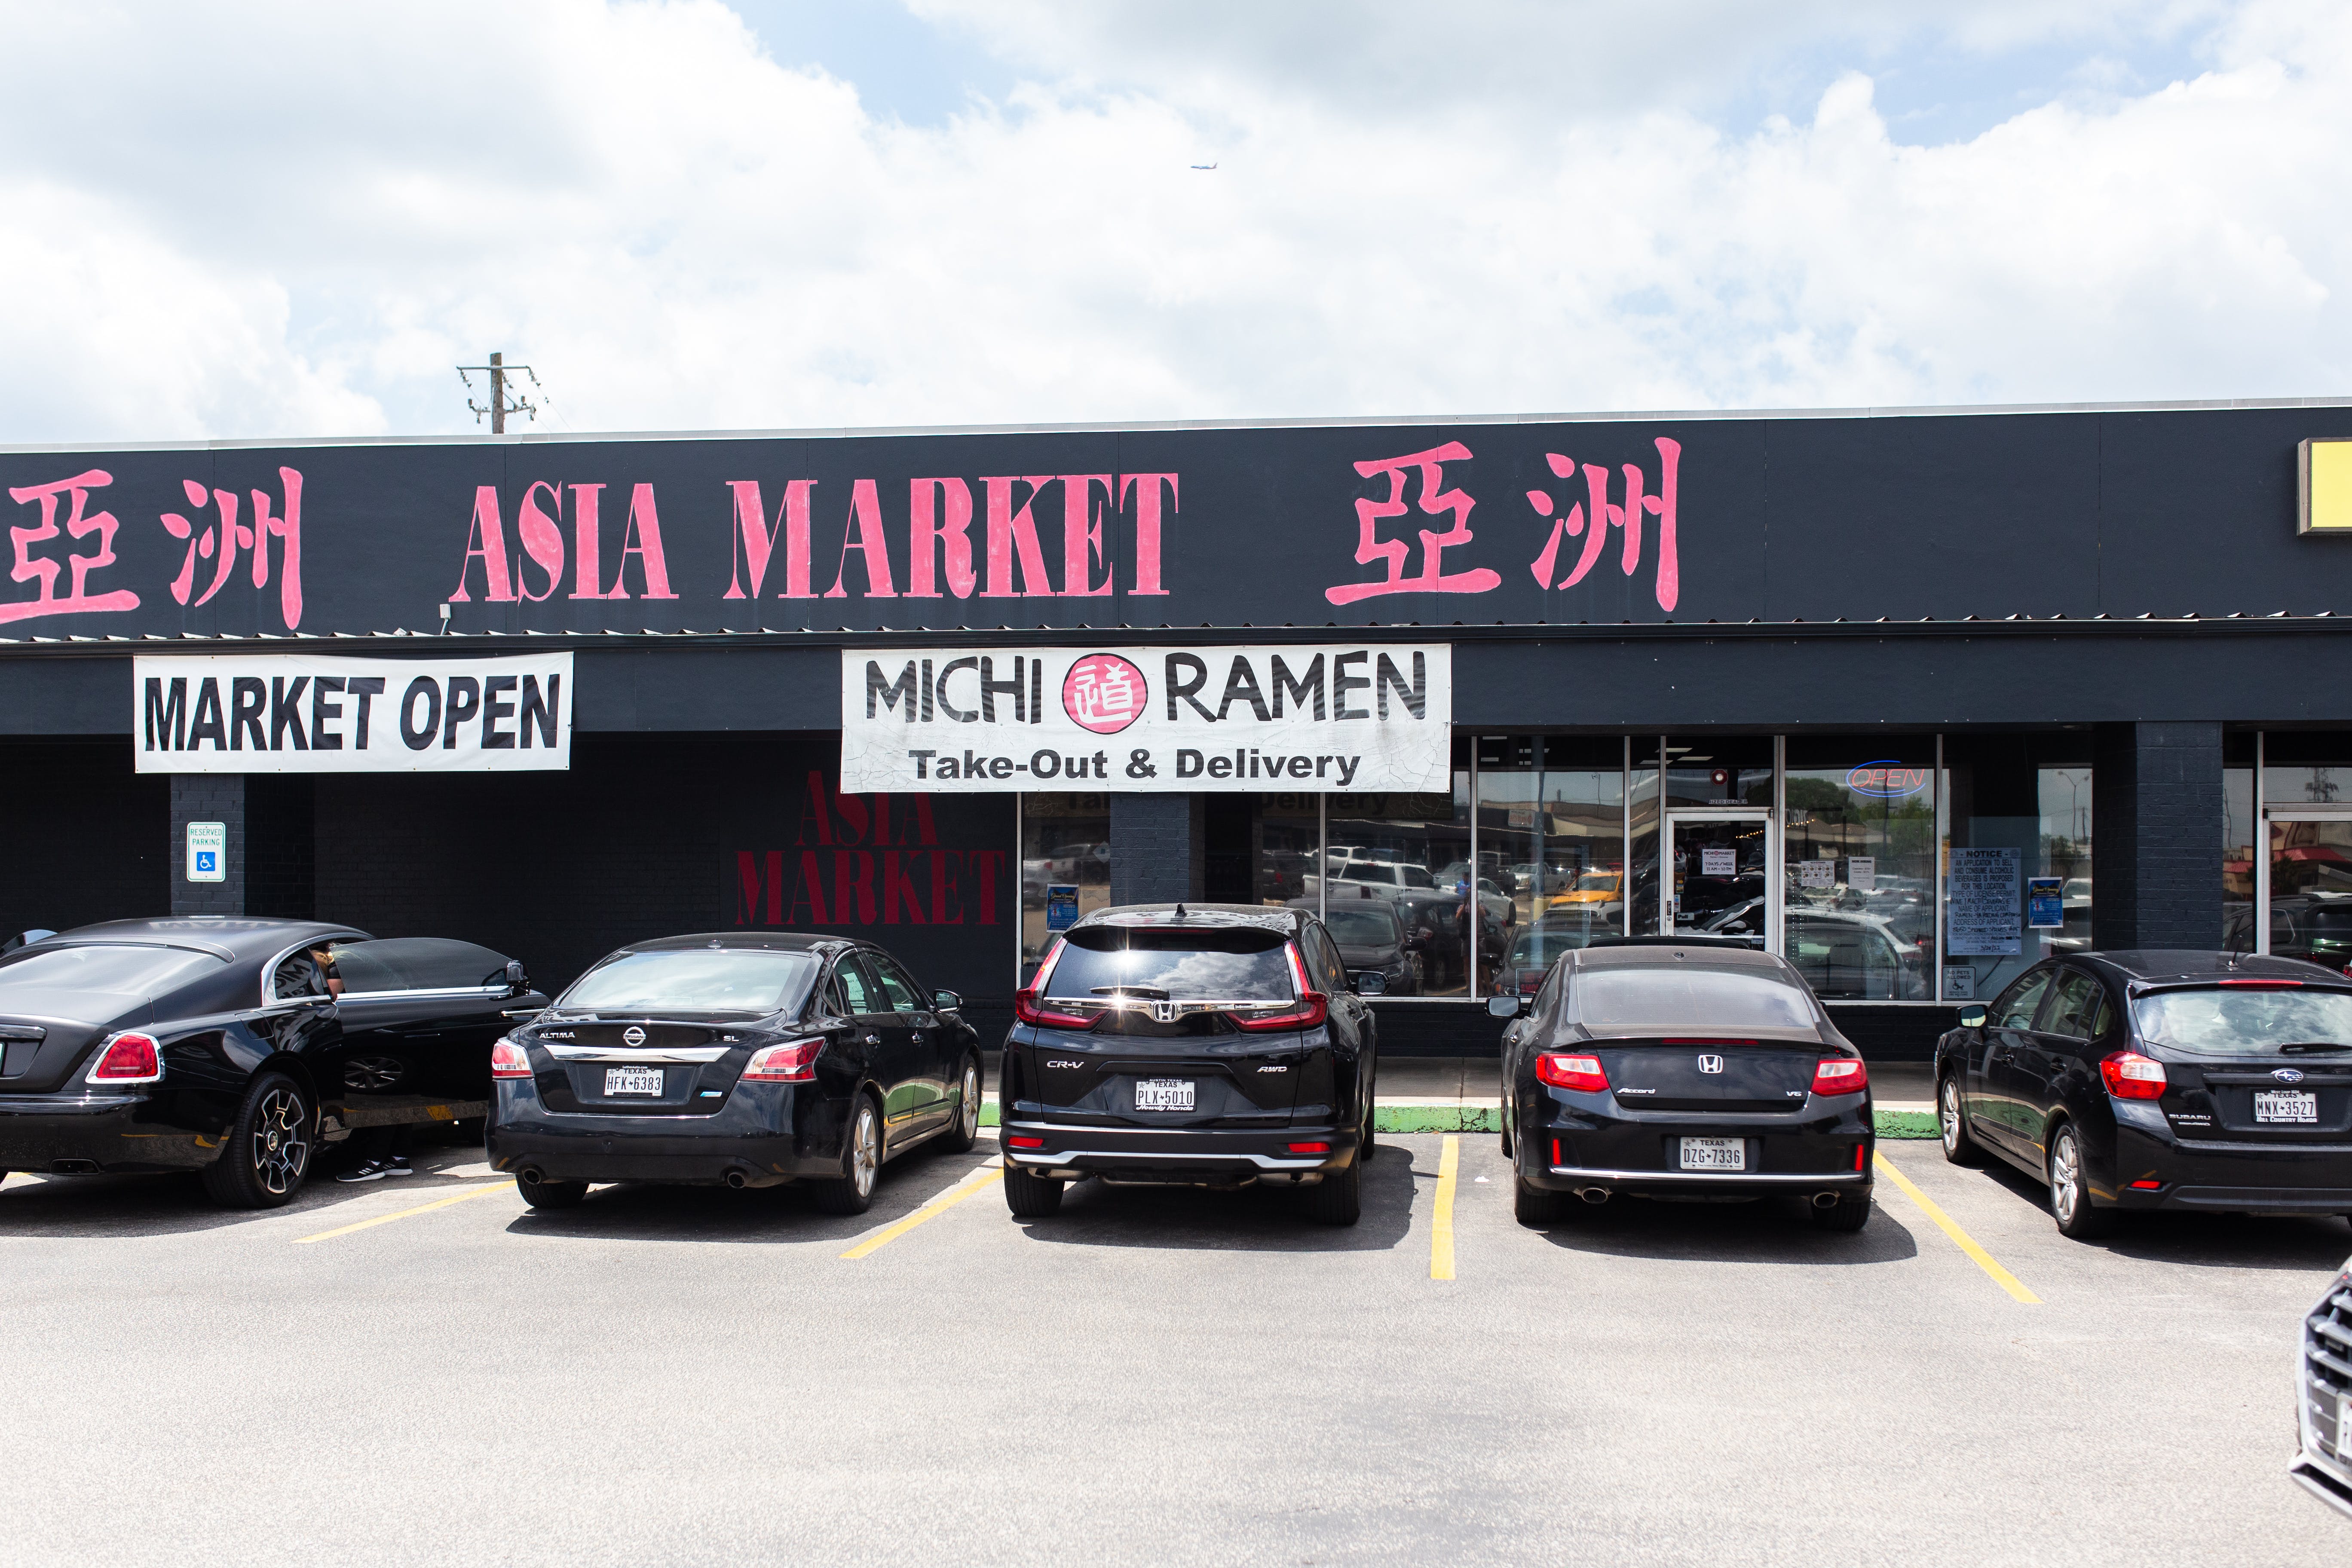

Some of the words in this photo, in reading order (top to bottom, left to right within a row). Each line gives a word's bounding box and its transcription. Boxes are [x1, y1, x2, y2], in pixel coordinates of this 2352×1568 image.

[0, 469, 303, 630] 亞洲
[448, 480, 680, 606] ASIA
[723, 473, 1179, 599] MARKET
[1325, 437, 1681, 612] 亞洲
[145, 676, 386, 751] MARKET
[400, 673, 560, 751] OPEN
[866, 655, 1041, 724] MICHI
[1166, 650, 1426, 723] RAMEN
[908, 749, 1108, 780] Take-Out
[1125, 749, 1158, 778] &
[1176, 748, 1361, 787] Delivery
[1851, 769, 1925, 787] OPEN
[793, 771, 941, 846] ASIA
[735, 850, 1005, 925] MARKET
